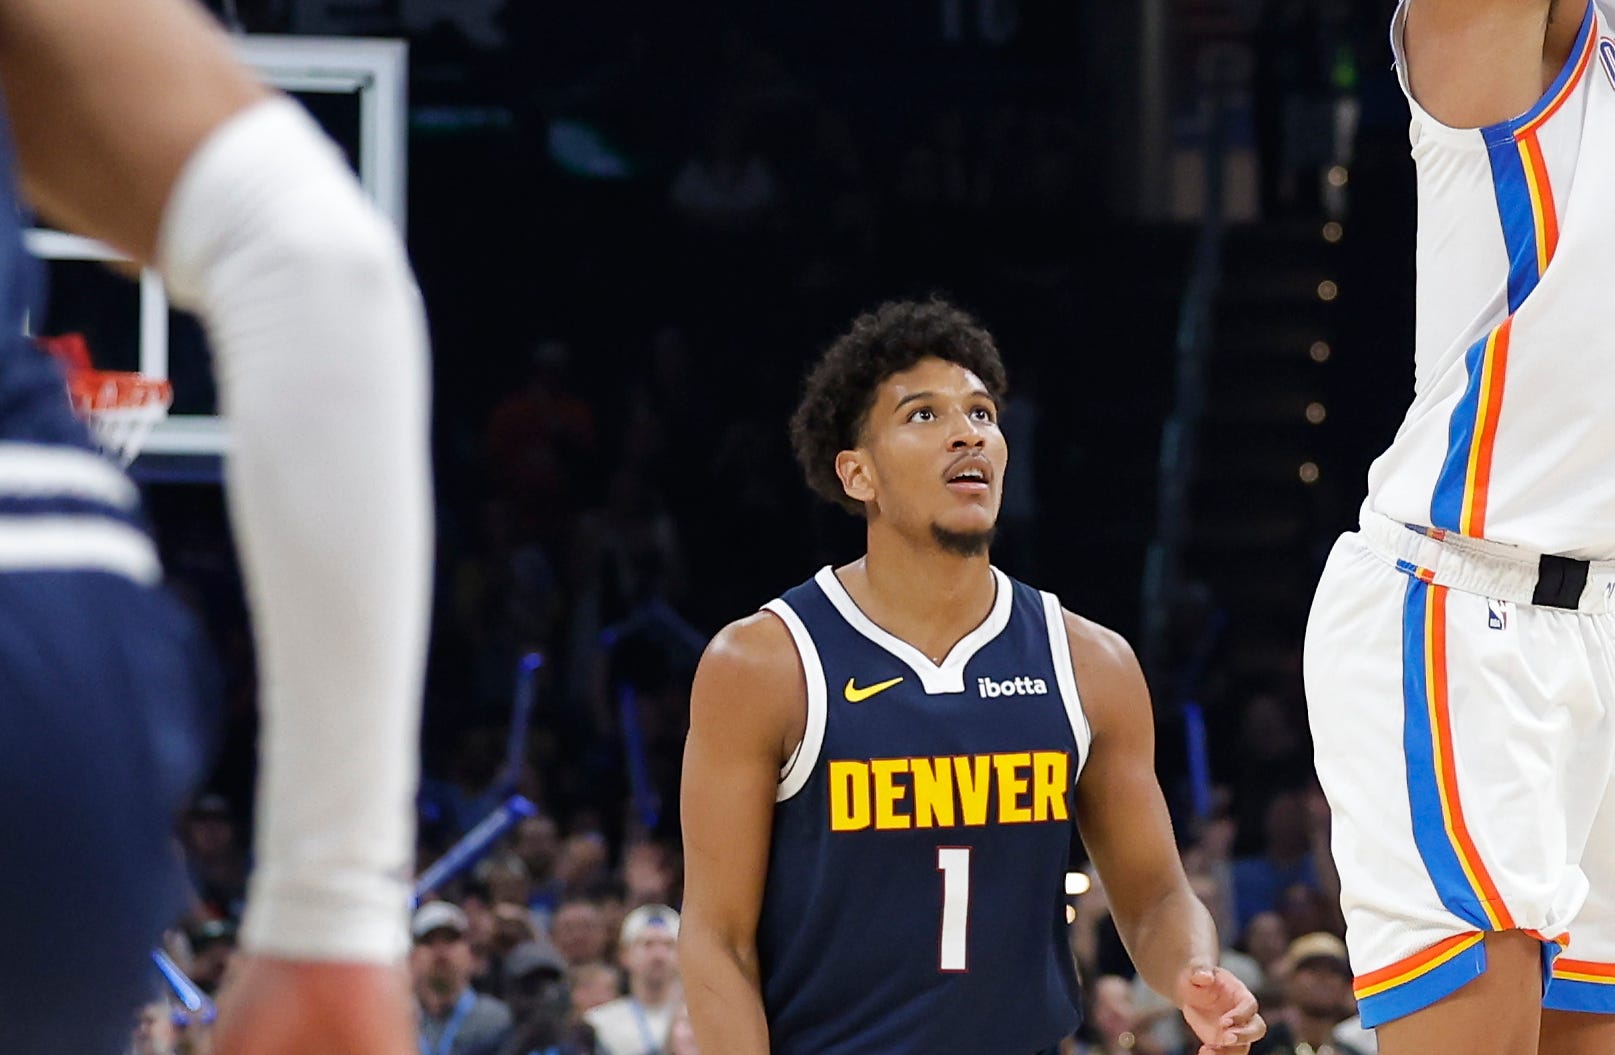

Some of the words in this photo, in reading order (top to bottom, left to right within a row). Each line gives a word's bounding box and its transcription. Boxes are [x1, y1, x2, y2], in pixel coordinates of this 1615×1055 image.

[977, 676, 1048, 698] ibotta
[829, 750, 1070, 832] DENVER
[936, 845, 972, 973] 1
